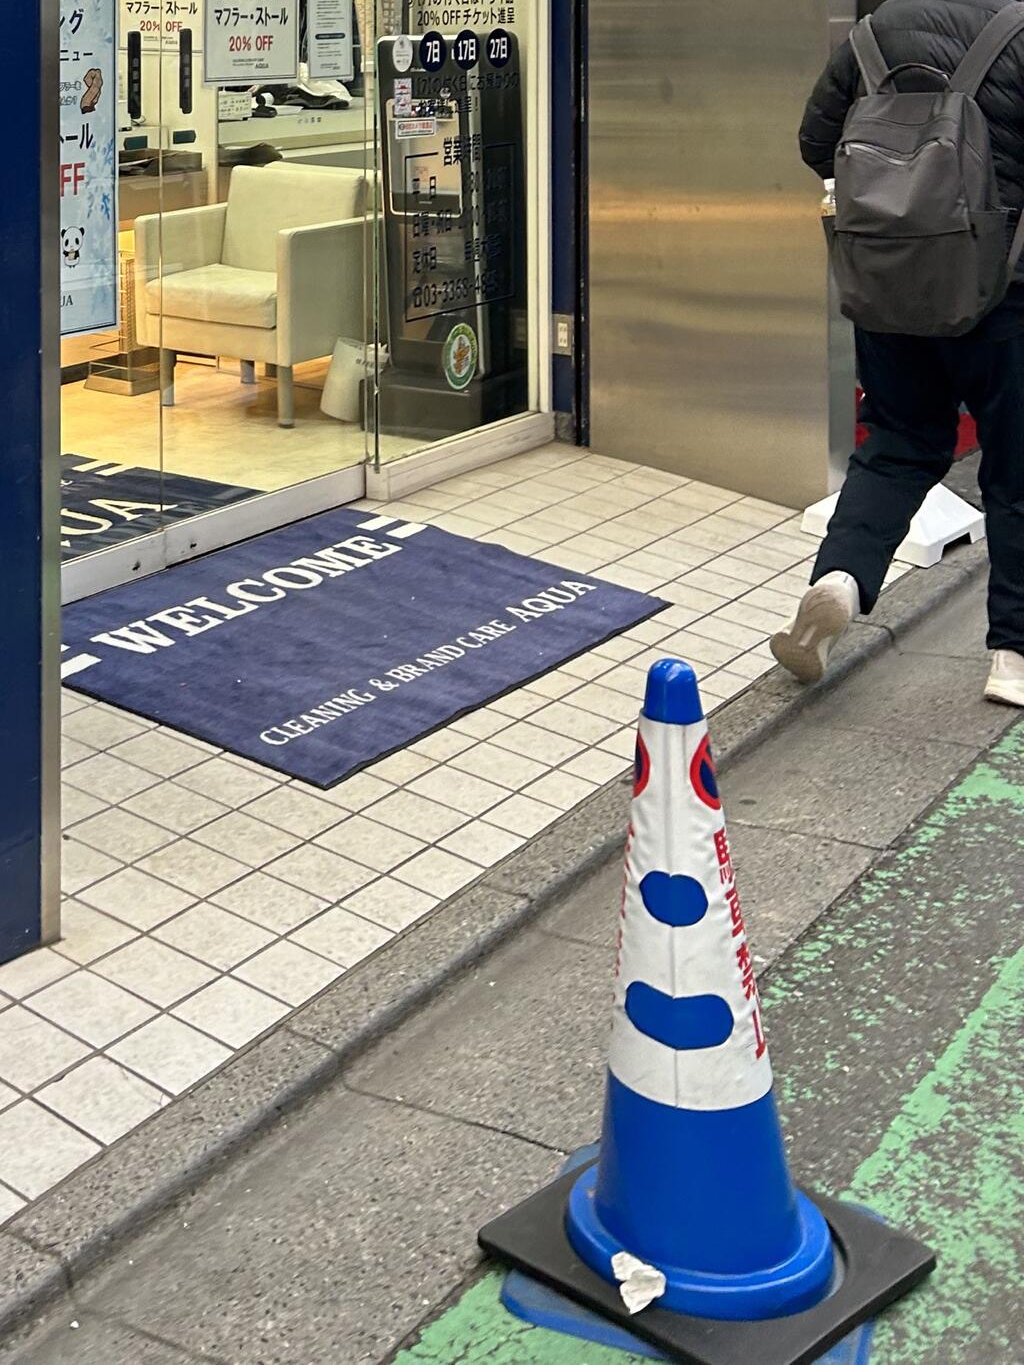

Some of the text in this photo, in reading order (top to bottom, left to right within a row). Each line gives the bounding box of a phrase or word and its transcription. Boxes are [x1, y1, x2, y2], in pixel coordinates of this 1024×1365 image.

[126, 0, 198, 15] マフラー・ストール
[214, 7, 289, 27] マフラー・ストール
[417, 7, 515, 26] 20% OFF チケット進呈
[139, 20, 183, 32] 20% OFF
[229, 35, 274, 52] 20% OFF
[426, 40, 440, 63] 7日
[458, 38, 476, 61] 17日
[490, 37, 508, 59] 27日
[89, 533, 403, 656] WELCOME
[258, 578, 598, 748] CLEANING & BRAND CARE AQUA
